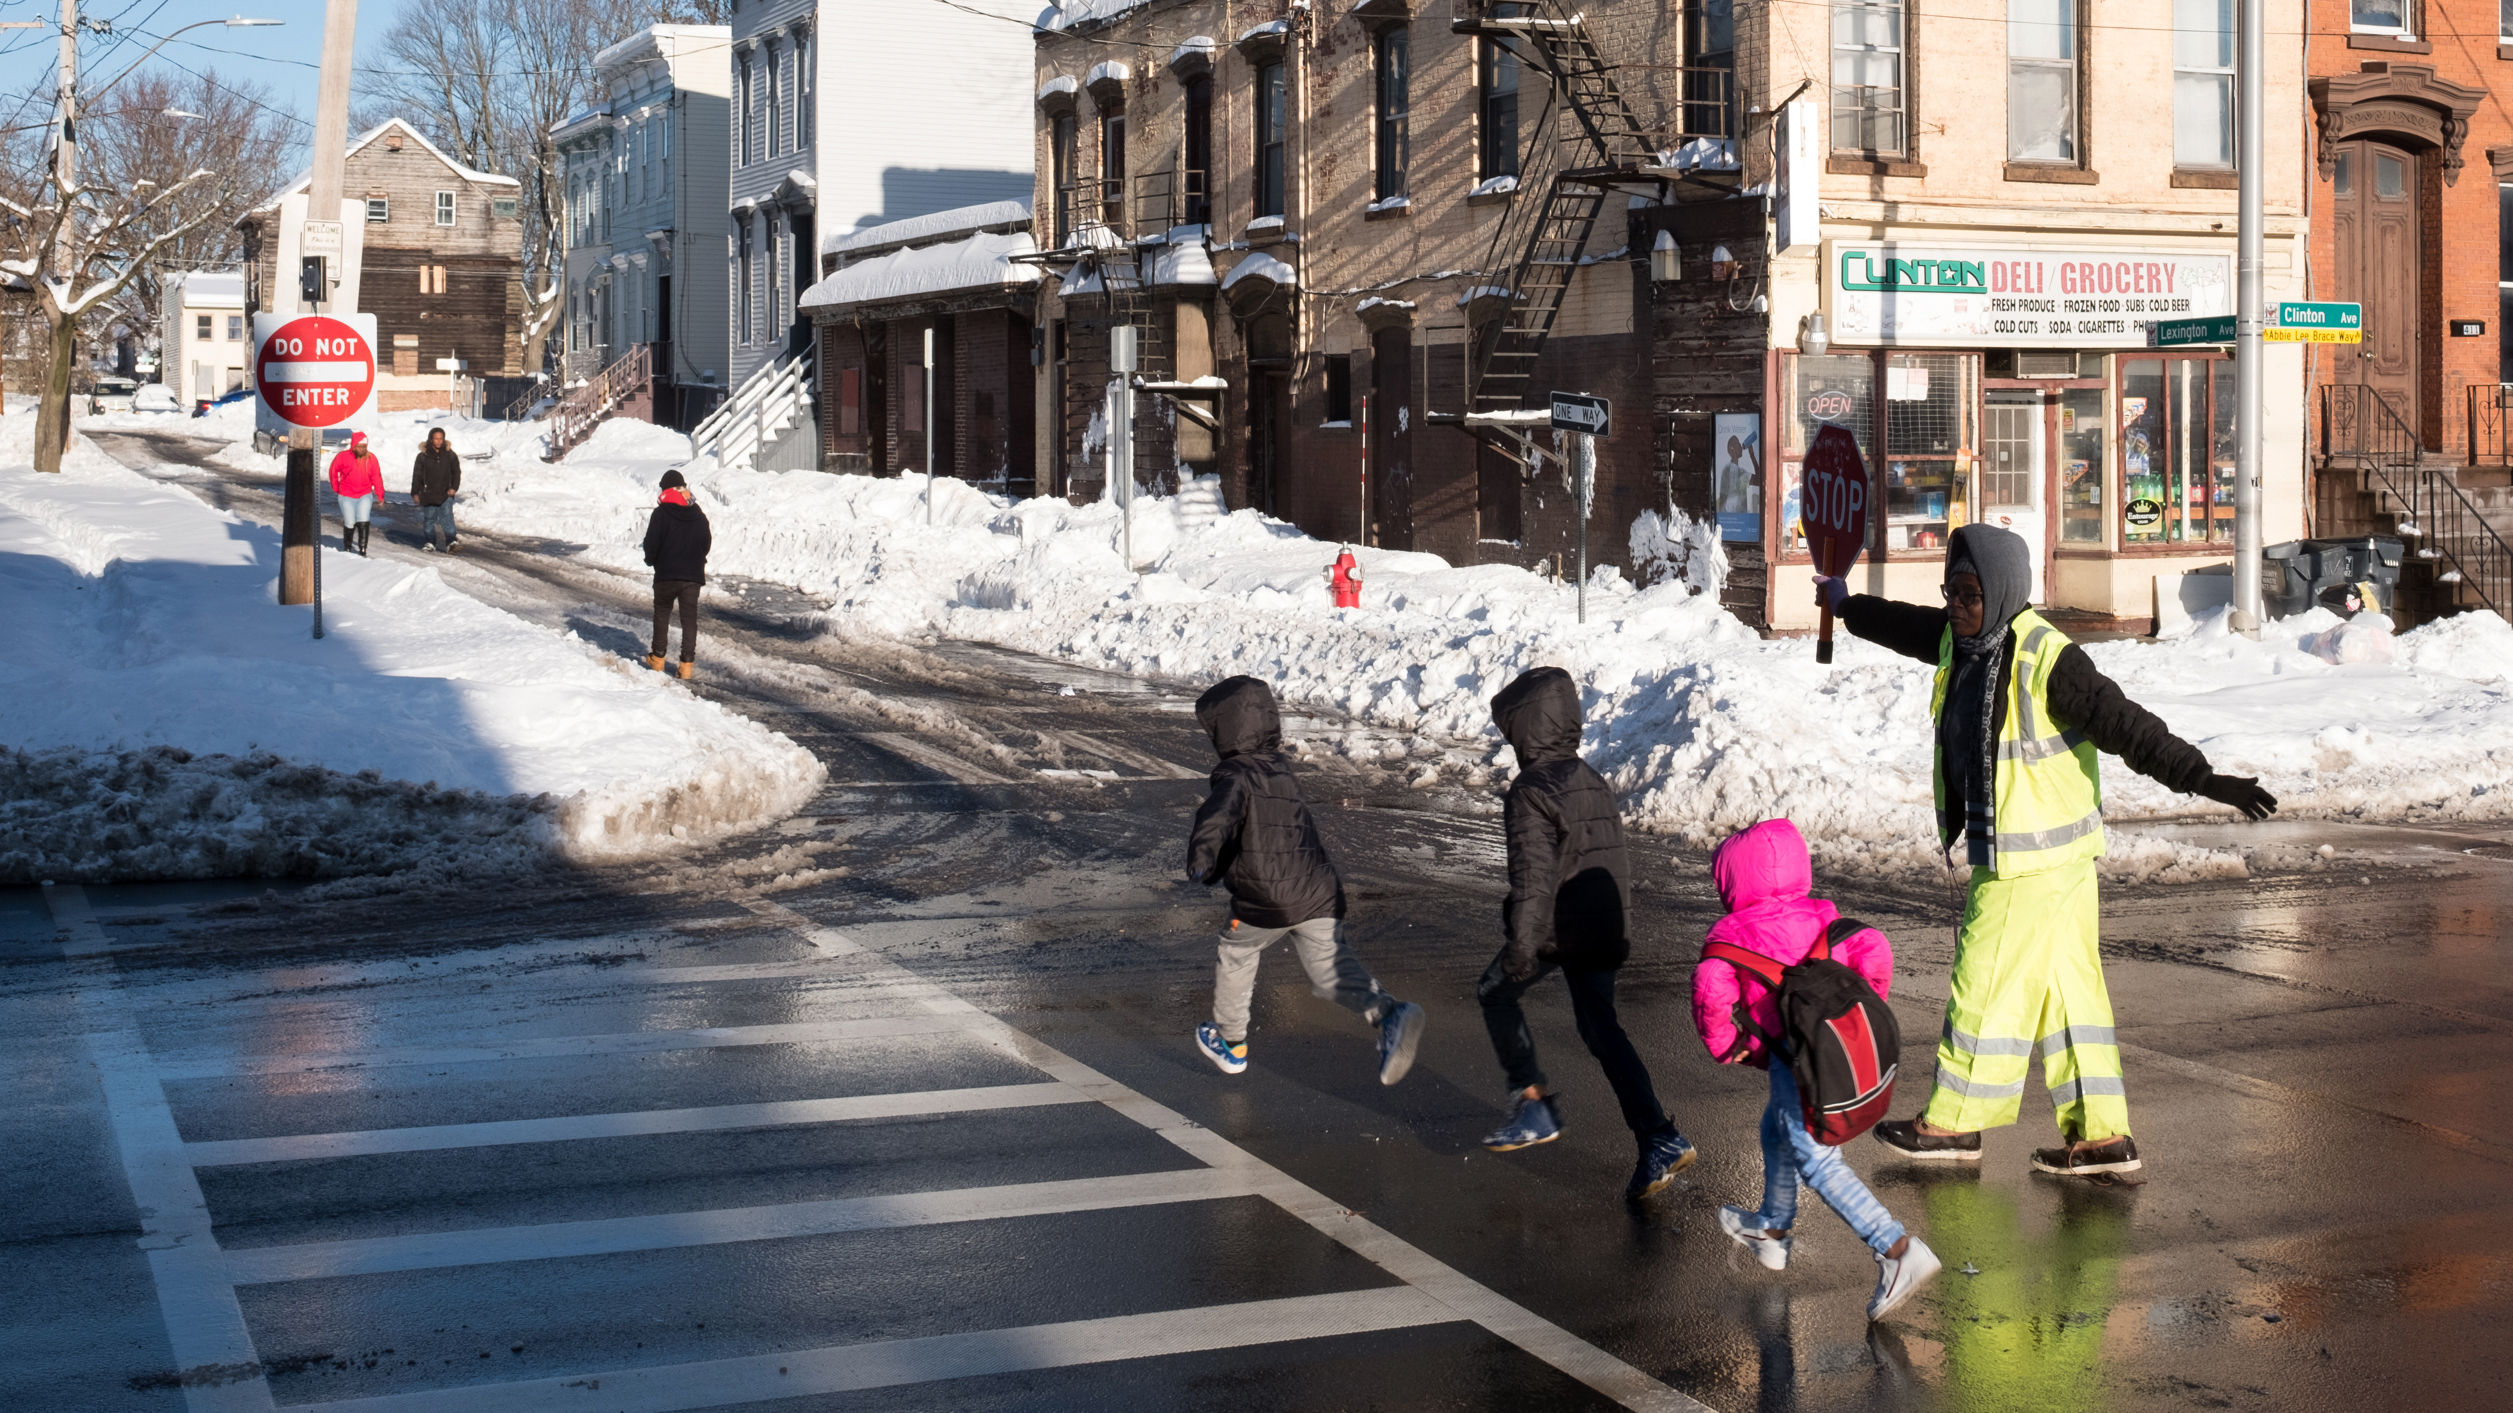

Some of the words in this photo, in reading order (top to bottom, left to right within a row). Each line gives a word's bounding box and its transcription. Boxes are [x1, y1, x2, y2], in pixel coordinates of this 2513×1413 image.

[306, 225, 340, 234] WELCOME
[1842, 251, 1987, 293] CLINTON
[1991, 260, 2043, 294] DELI
[2060, 262, 2177, 295] GROCERY
[1991, 299, 2016, 312] FRESH
[2018, 299, 2056, 313] PRODUCE
[2064, 300, 2096, 313] FROZEN
[2098, 300, 2120, 313] FOOD
[2125, 299, 2145, 312] SUBS
[2149, 299, 2170, 312] COLD
[2171, 299, 2190, 312] BEER
[2284, 306, 2326, 323] Clinton
[2340, 312, 2357, 324] Ave
[1994, 320, 2016, 333] COLD
[2018, 320, 2038, 334] CUTS
[2048, 320, 2072, 334] SODA
[2078, 320, 2125, 333] CIGARETTES
[2160, 323, 2208, 342] Lexington
[2218, 324, 2234, 335] Ave
[2464, 326, 2478, 334] 411
[2268, 330, 2292, 341] Abbie
[2295, 330, 2309, 341] Lee
[2312, 330, 2335, 341] Brace
[2338, 331, 2355, 343] Way
[275, 338, 303, 356] DO
[316, 338, 358, 356] NOT
[283, 388, 349, 406] ENTER
[1808, 397, 1852, 414] OPEN
[1555, 404, 1572, 419] ONE
[1582, 407, 1601, 423] WAY
[1718, 425, 1731, 433] Drink
[1731, 425, 1747, 433] Water
[1806, 468, 1863, 533] STOP
[2127, 512, 2159, 520] Entourage
